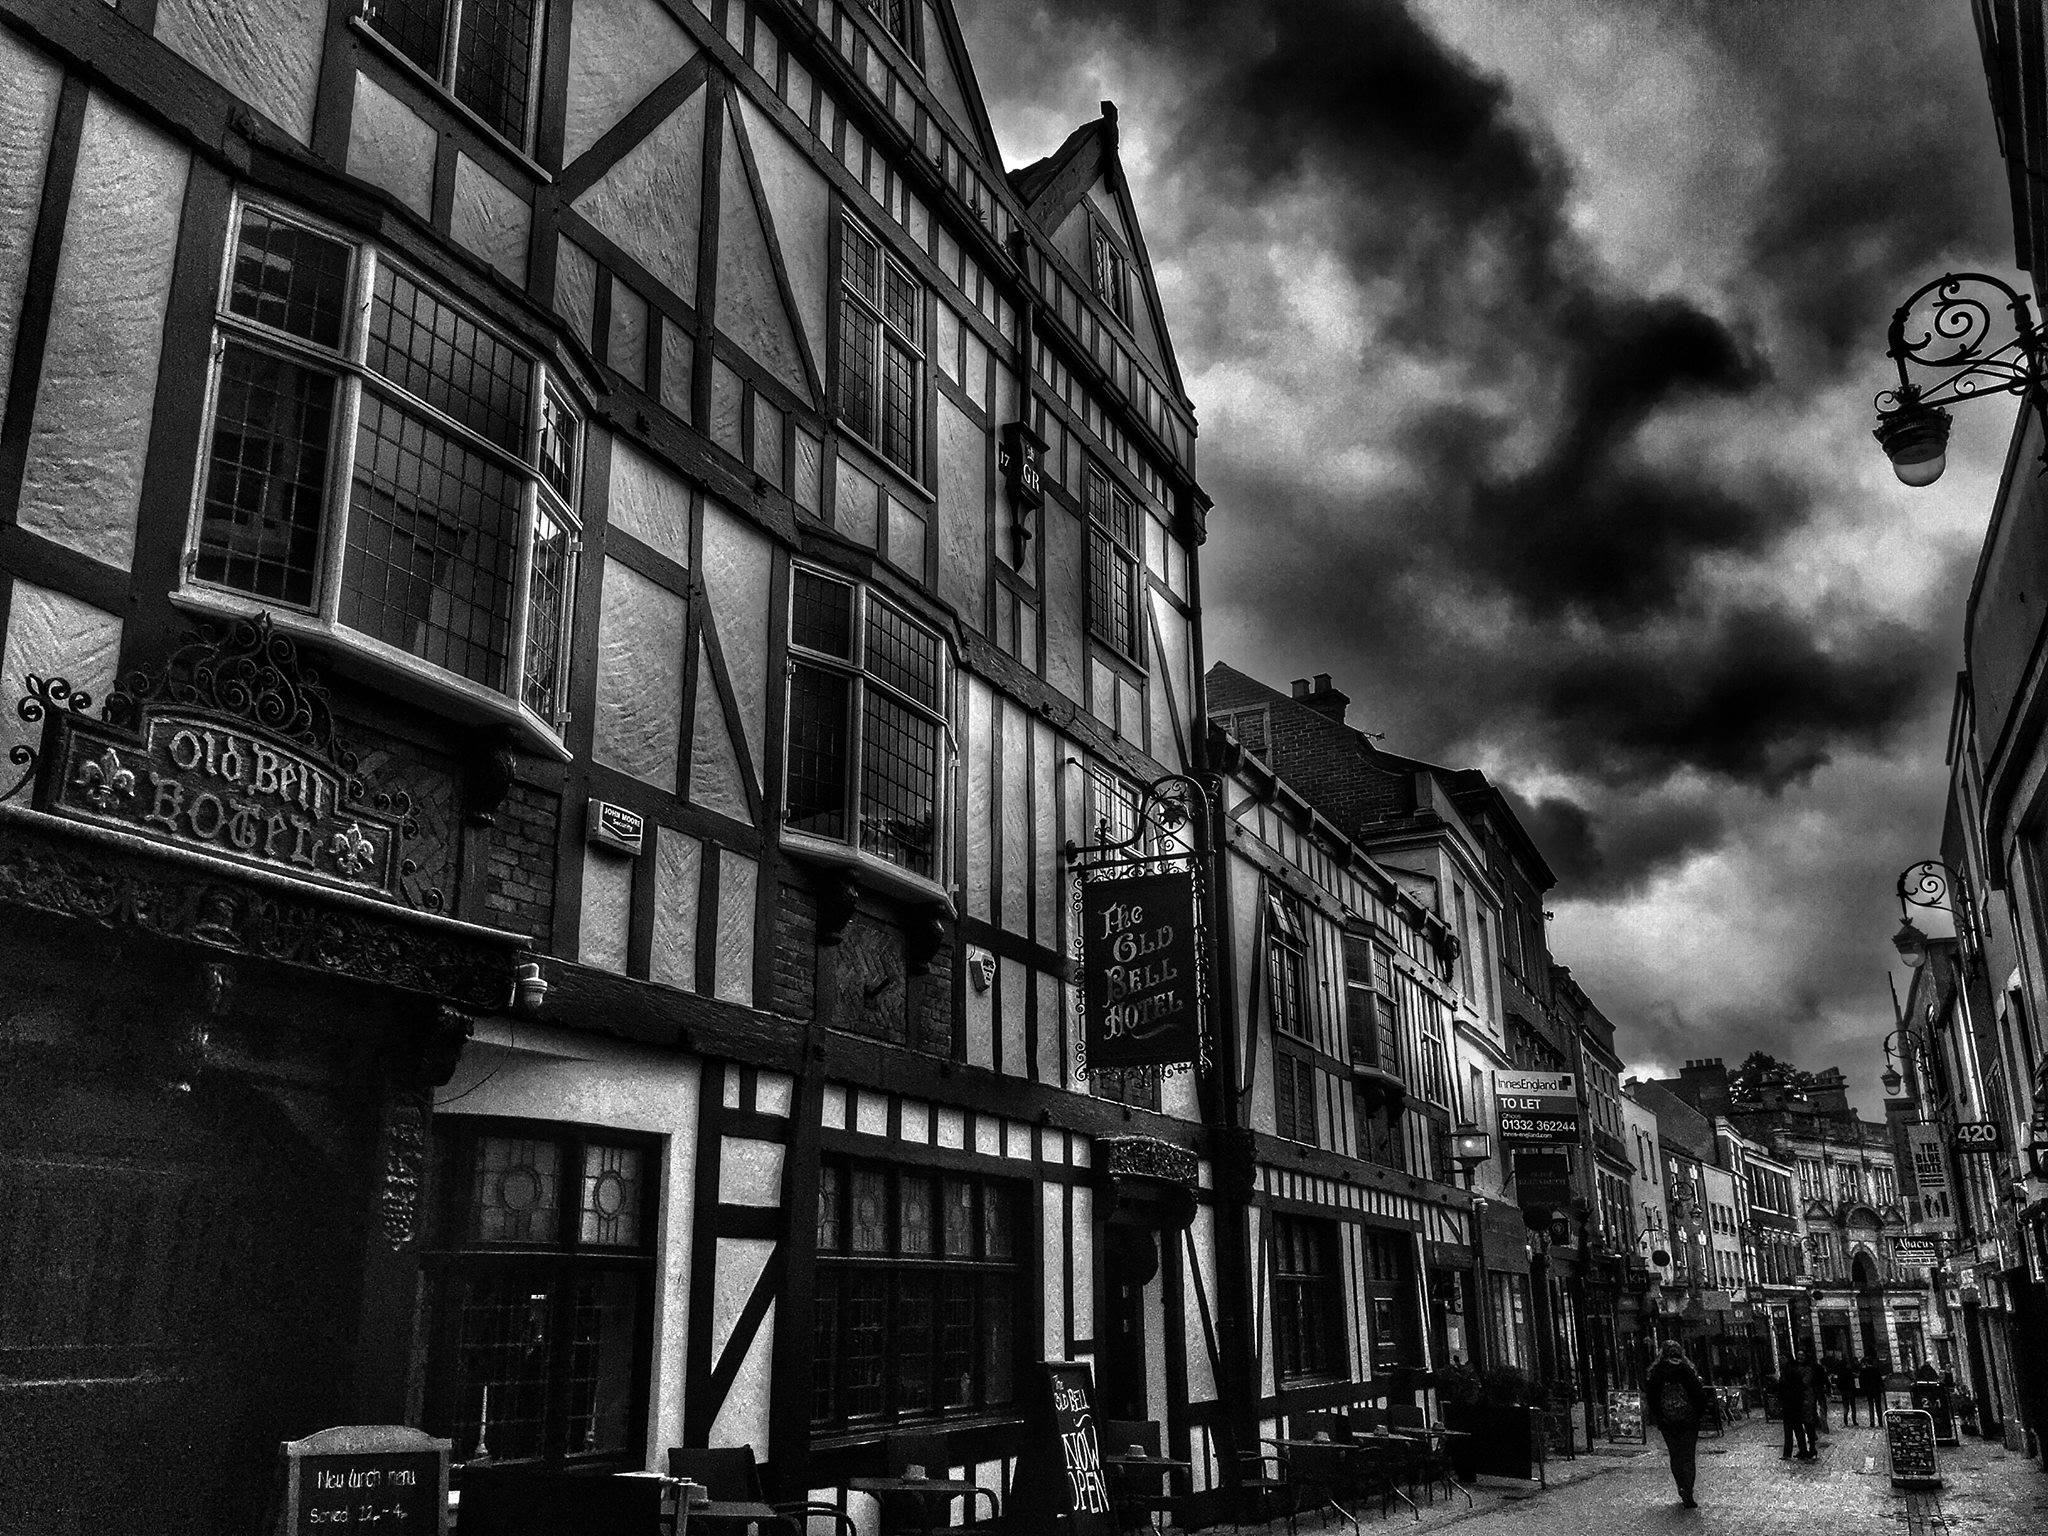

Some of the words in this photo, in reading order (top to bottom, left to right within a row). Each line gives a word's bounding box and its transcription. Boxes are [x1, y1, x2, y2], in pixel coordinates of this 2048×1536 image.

[1023, 464, 1040, 493] GR
[169, 729, 243, 783] Old
[1097, 902, 1143, 940] The
[1112, 924, 1174, 963] OLD
[1103, 958, 1178, 1008] BELL
[1102, 990, 1184, 1041] HOTEL
[1498, 1078, 1557, 1092] InnesEngland
[1501, 1098, 1516, 1109] TO
[1520, 1099, 1541, 1109] LET
[1502, 1119, 1534, 1130] 01332
[1536, 1120, 1576, 1132] 362244
[1957, 1124, 1997, 1143] 420
[1919, 1143, 1939, 1152] THE
[1916, 1153, 1941, 1163] BLUE
[1895, 1238, 1935, 1251] Abacus
[1061, 1425, 1100, 1472] NOW
[317, 1470, 344, 1489] New
